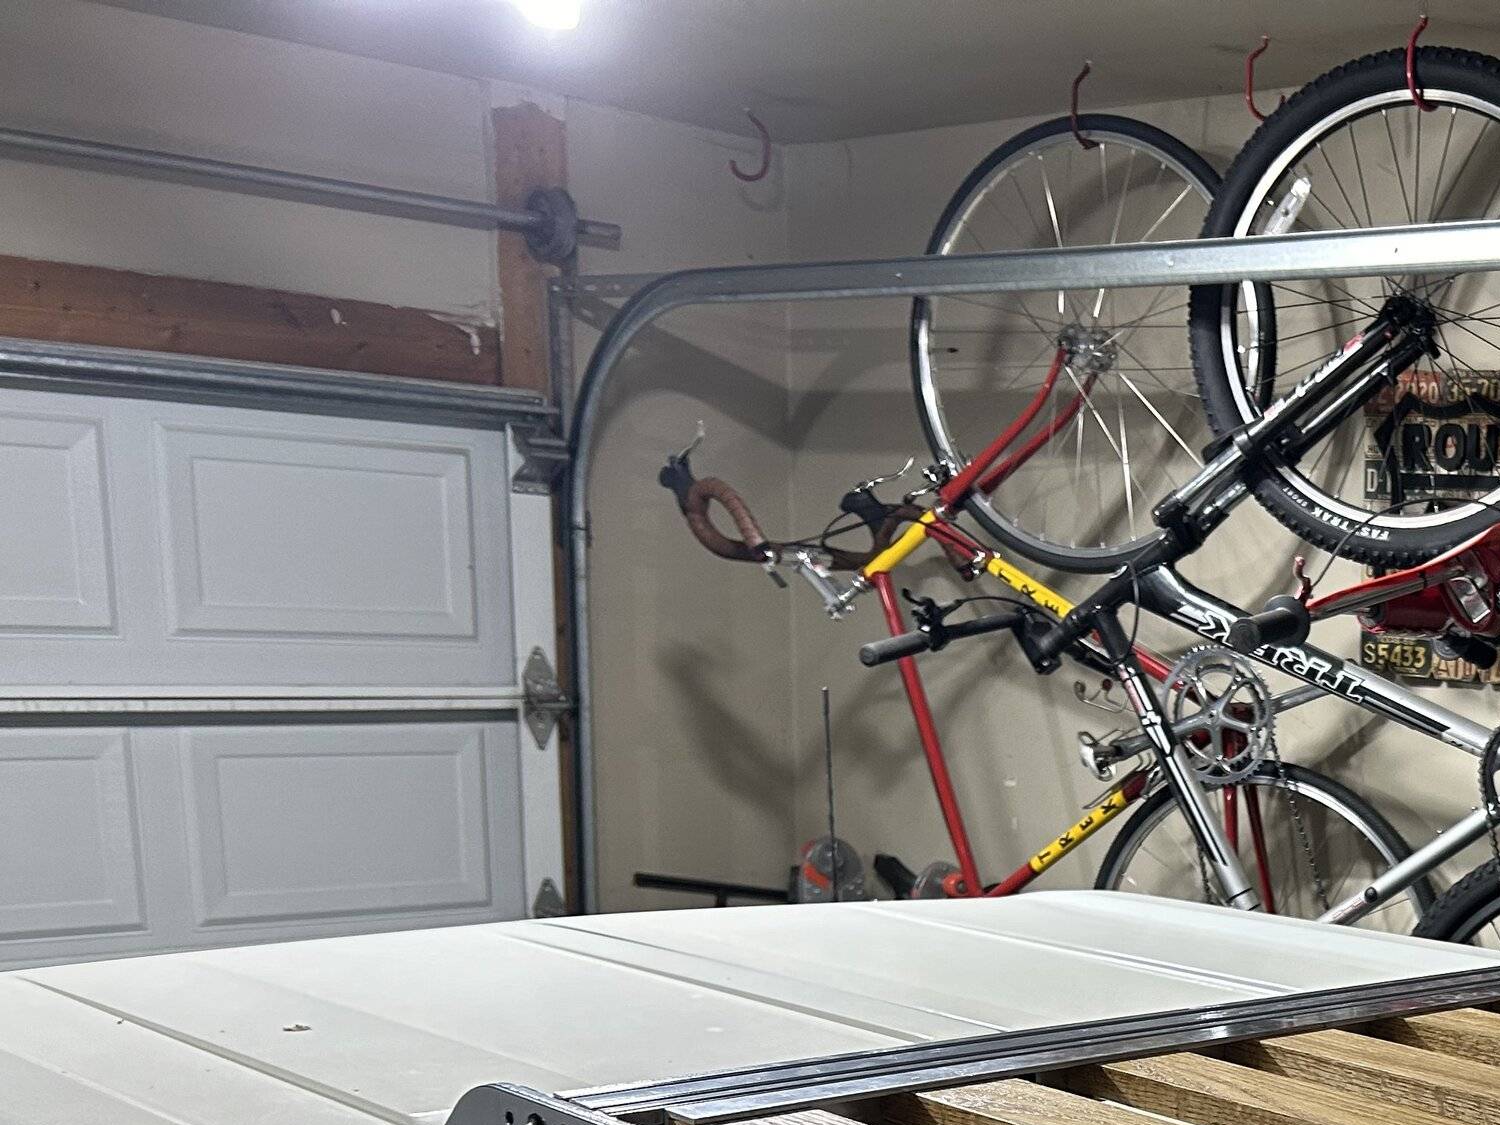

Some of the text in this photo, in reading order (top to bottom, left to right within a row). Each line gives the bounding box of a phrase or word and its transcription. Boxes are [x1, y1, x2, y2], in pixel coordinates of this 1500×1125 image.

[1282, 486, 1308, 508] SPORT
[1312, 506, 1350, 532] TRAK
[1038, 798, 1121, 865] TREK
